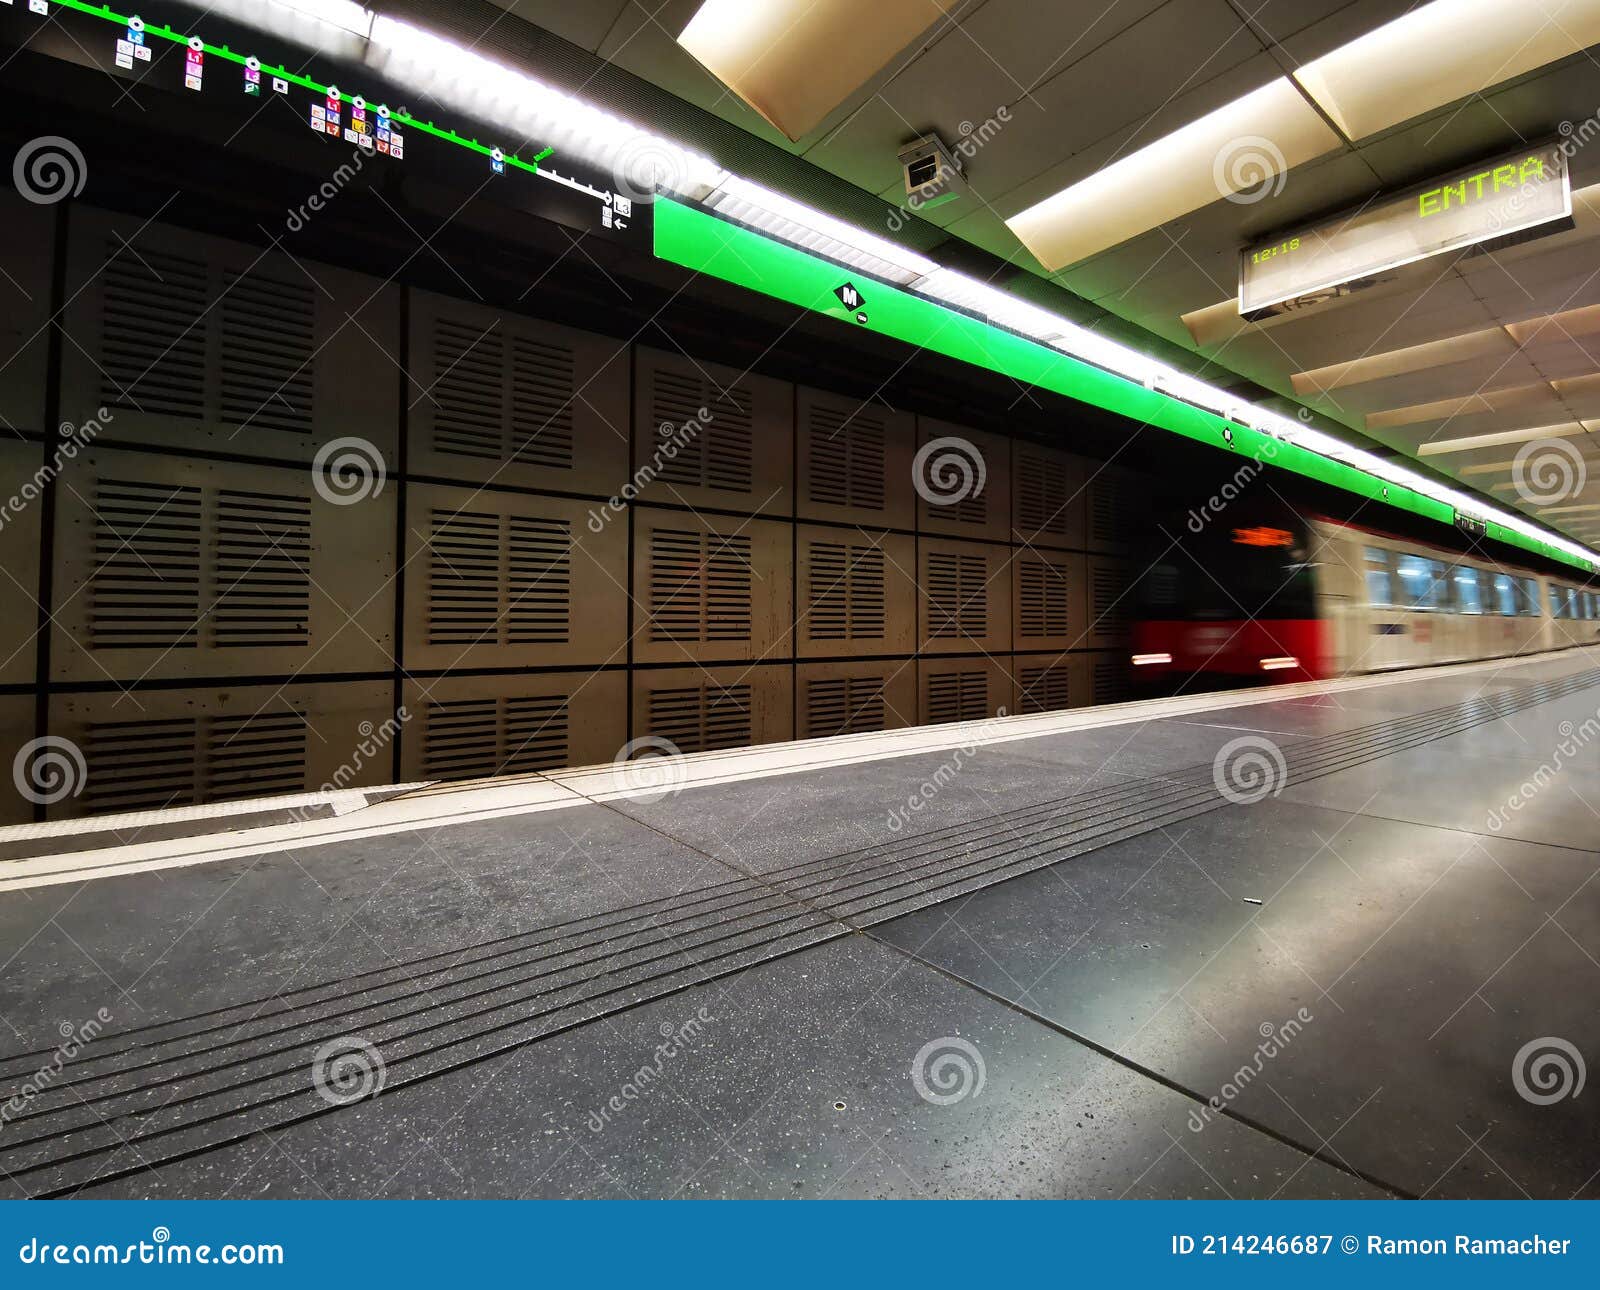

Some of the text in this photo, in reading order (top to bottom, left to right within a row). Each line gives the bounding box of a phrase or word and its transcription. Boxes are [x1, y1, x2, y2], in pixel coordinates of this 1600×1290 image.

[1419, 156, 1543, 218] ENTRA
[616, 201, 629, 215] L3
[1252, 238, 1301, 264] 12:18
[843, 286, 857, 306] M
